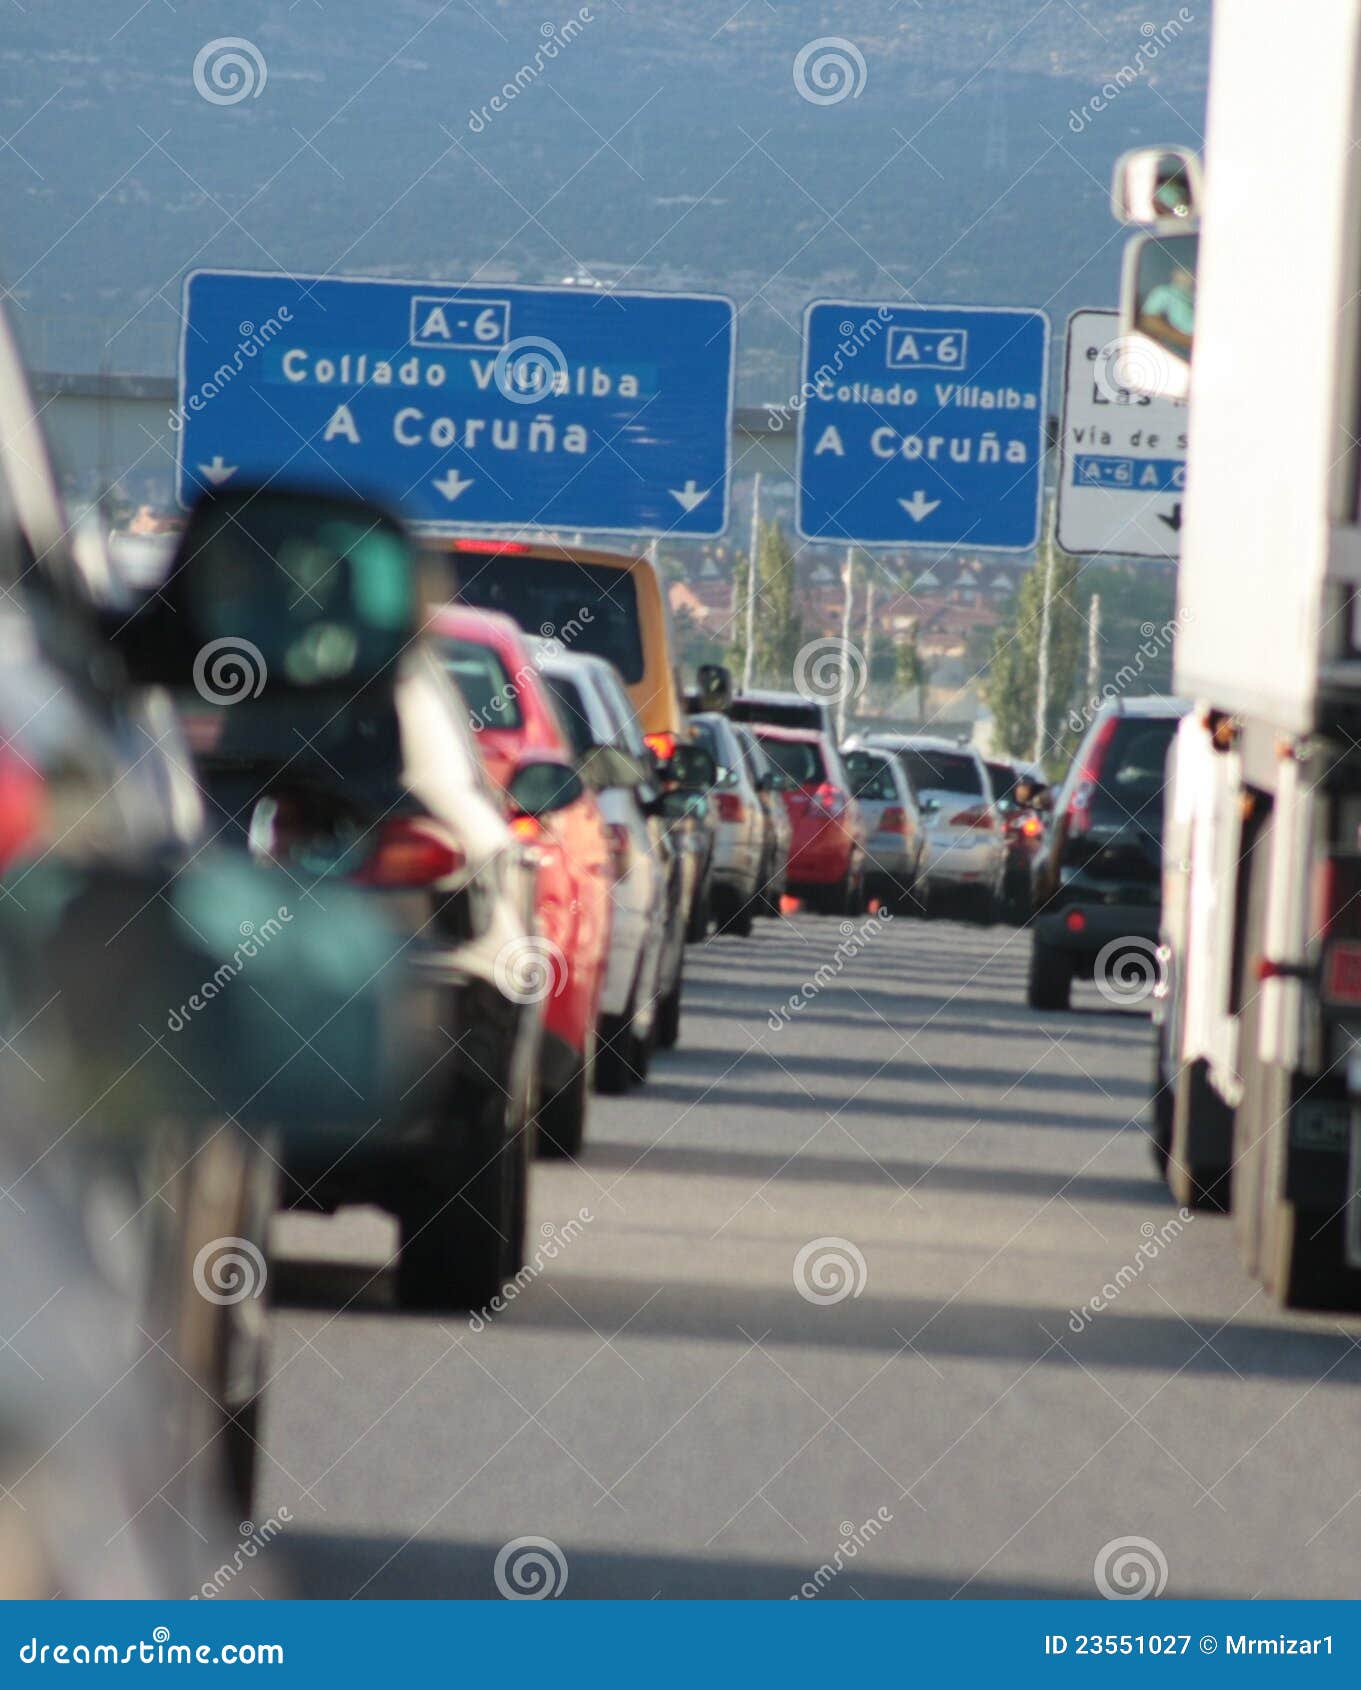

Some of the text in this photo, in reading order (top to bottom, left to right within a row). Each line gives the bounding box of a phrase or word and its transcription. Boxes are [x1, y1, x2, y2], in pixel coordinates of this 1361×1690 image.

[421, 309, 501, 341] A-6
[896, 336, 960, 363] A-6
[281, 349, 640, 399] Collado Villalba
[817, 381, 1037, 410] Collado Villalba
[324, 405, 589, 454] A Coruña
[814, 425, 1027, 463] A Coruña
[1130, 430, 1160, 447] de
[1086, 463, 1188, 488] A-6 A C
